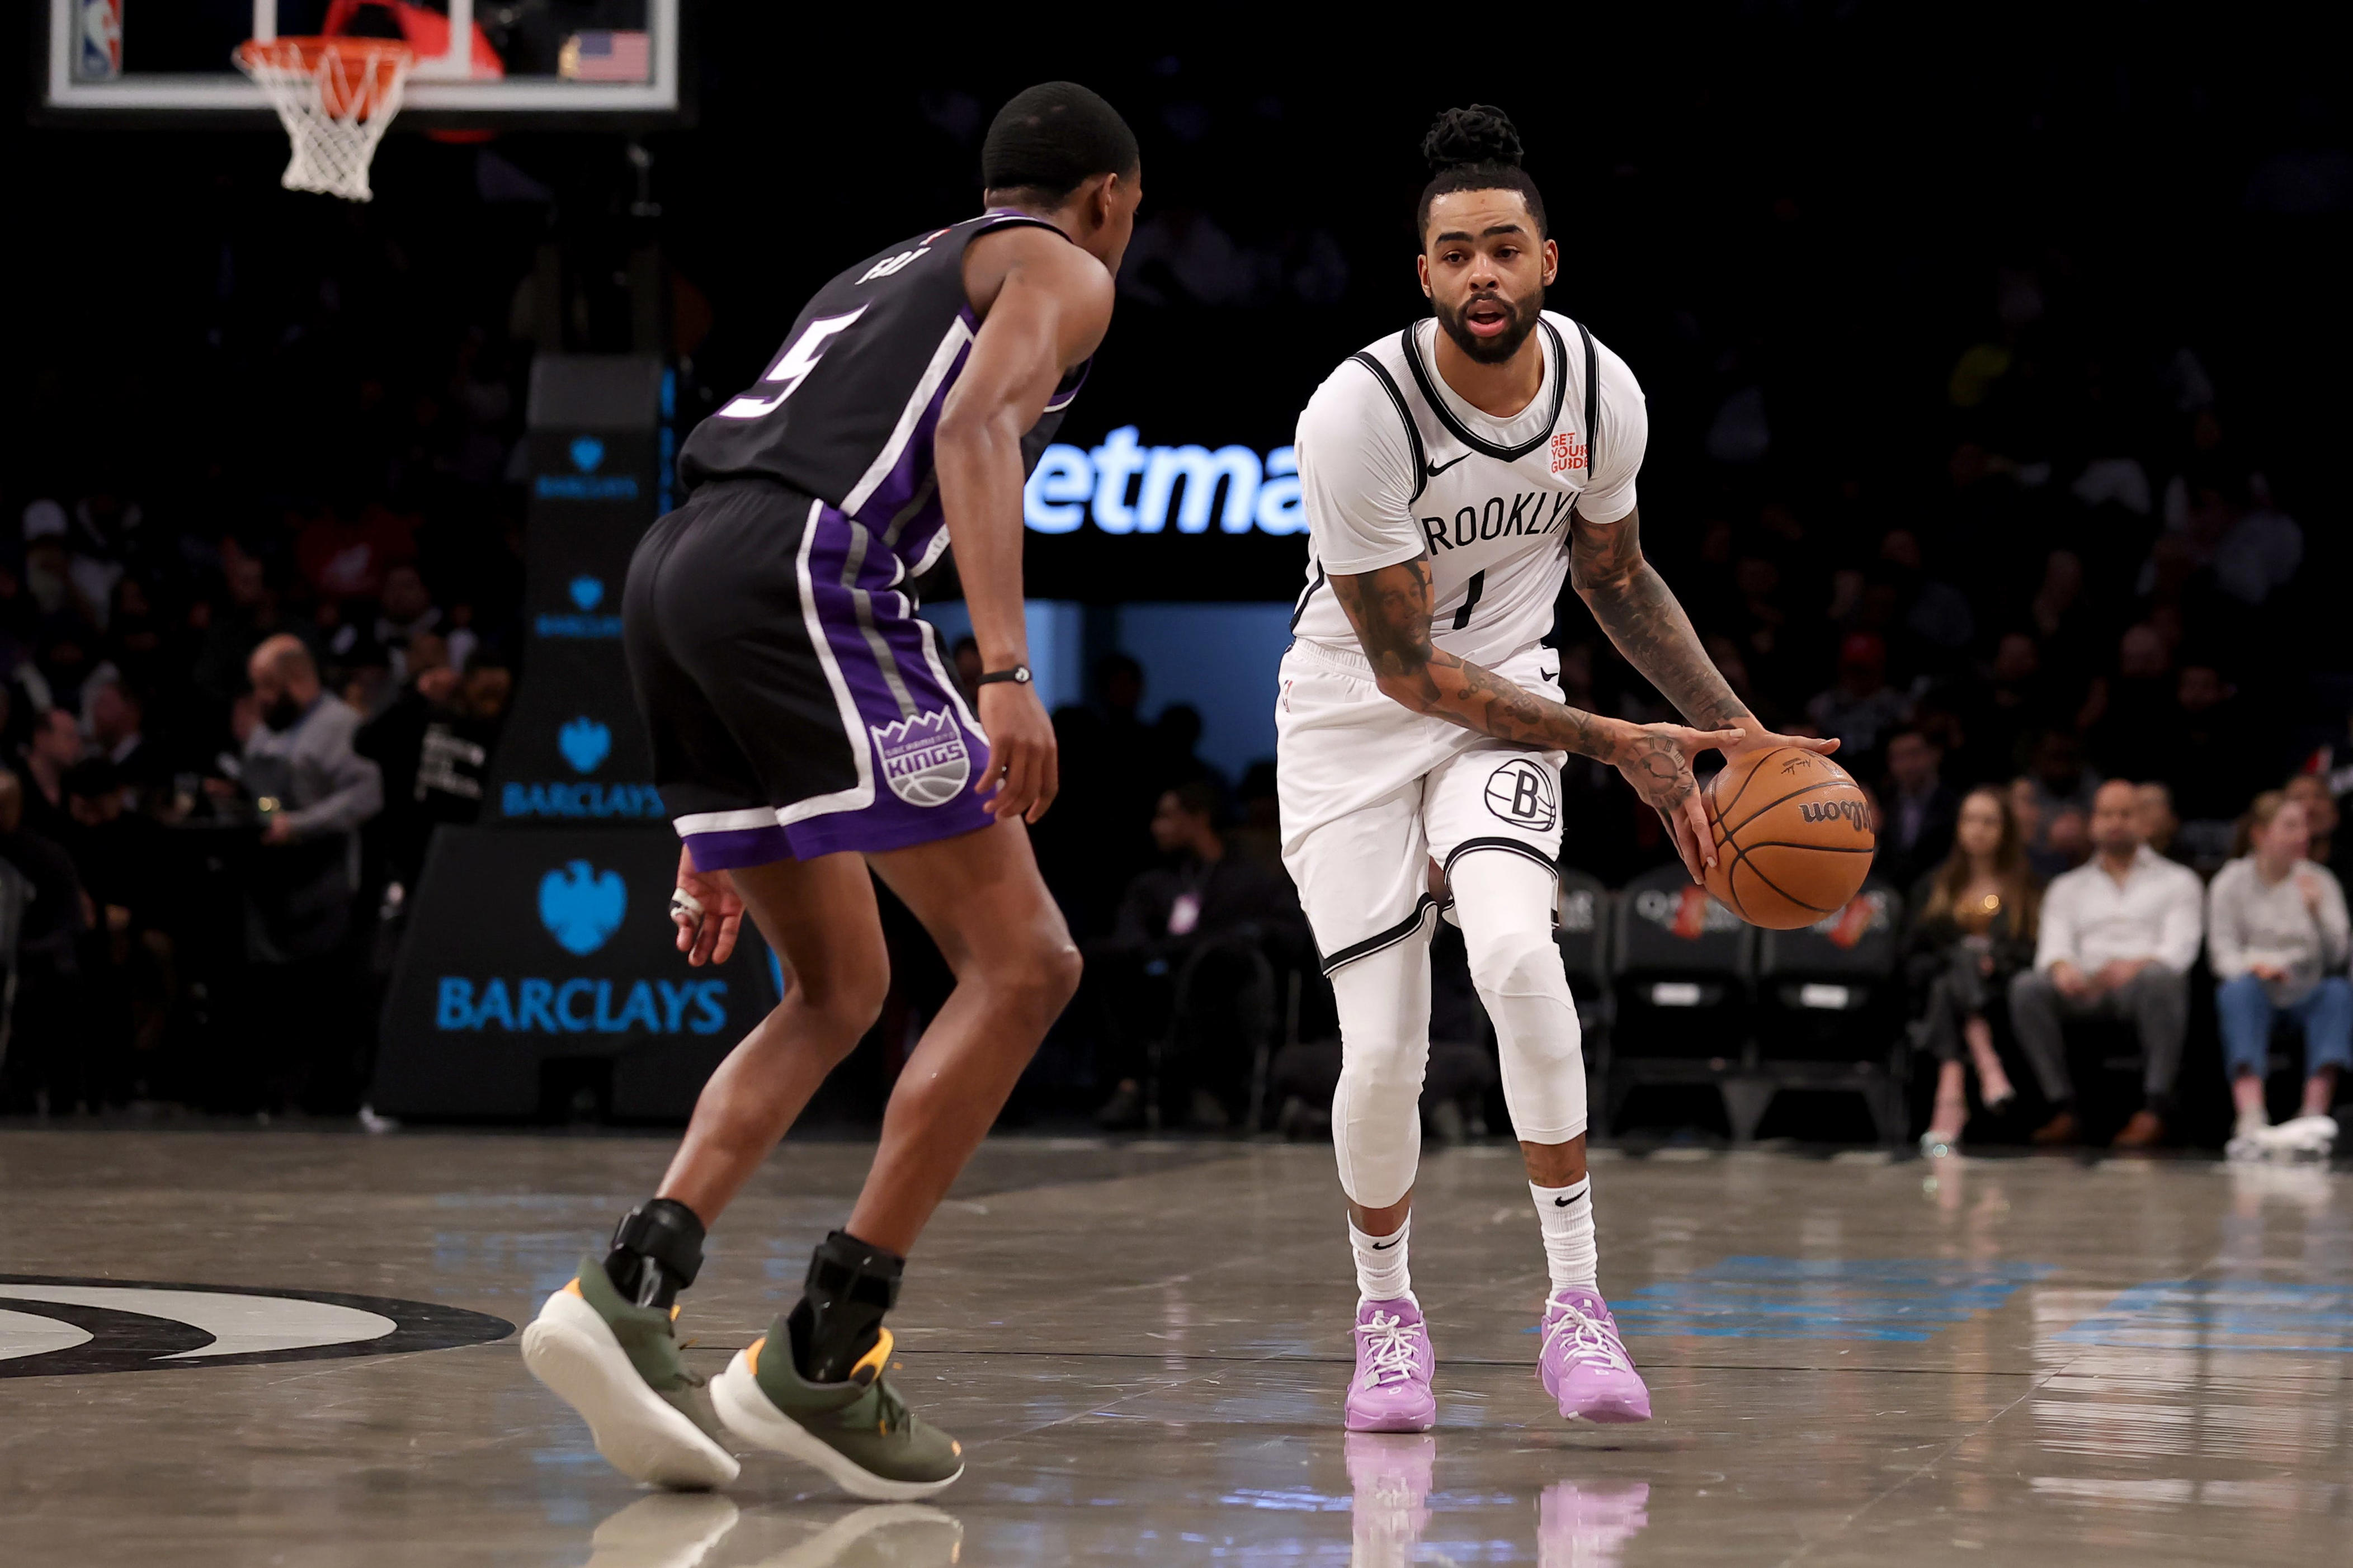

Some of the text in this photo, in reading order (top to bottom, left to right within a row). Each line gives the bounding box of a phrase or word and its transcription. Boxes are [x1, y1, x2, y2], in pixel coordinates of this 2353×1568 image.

[715, 301, 871, 418] 5
[1551, 432, 1576, 448] GET
[1024, 424, 1310, 535] etma
[1452, 568, 1486, 630] 1
[888, 744, 964, 778] KINGS
[1512, 769, 1539, 819] B
[436, 975, 728, 1035] BARCLAYS
